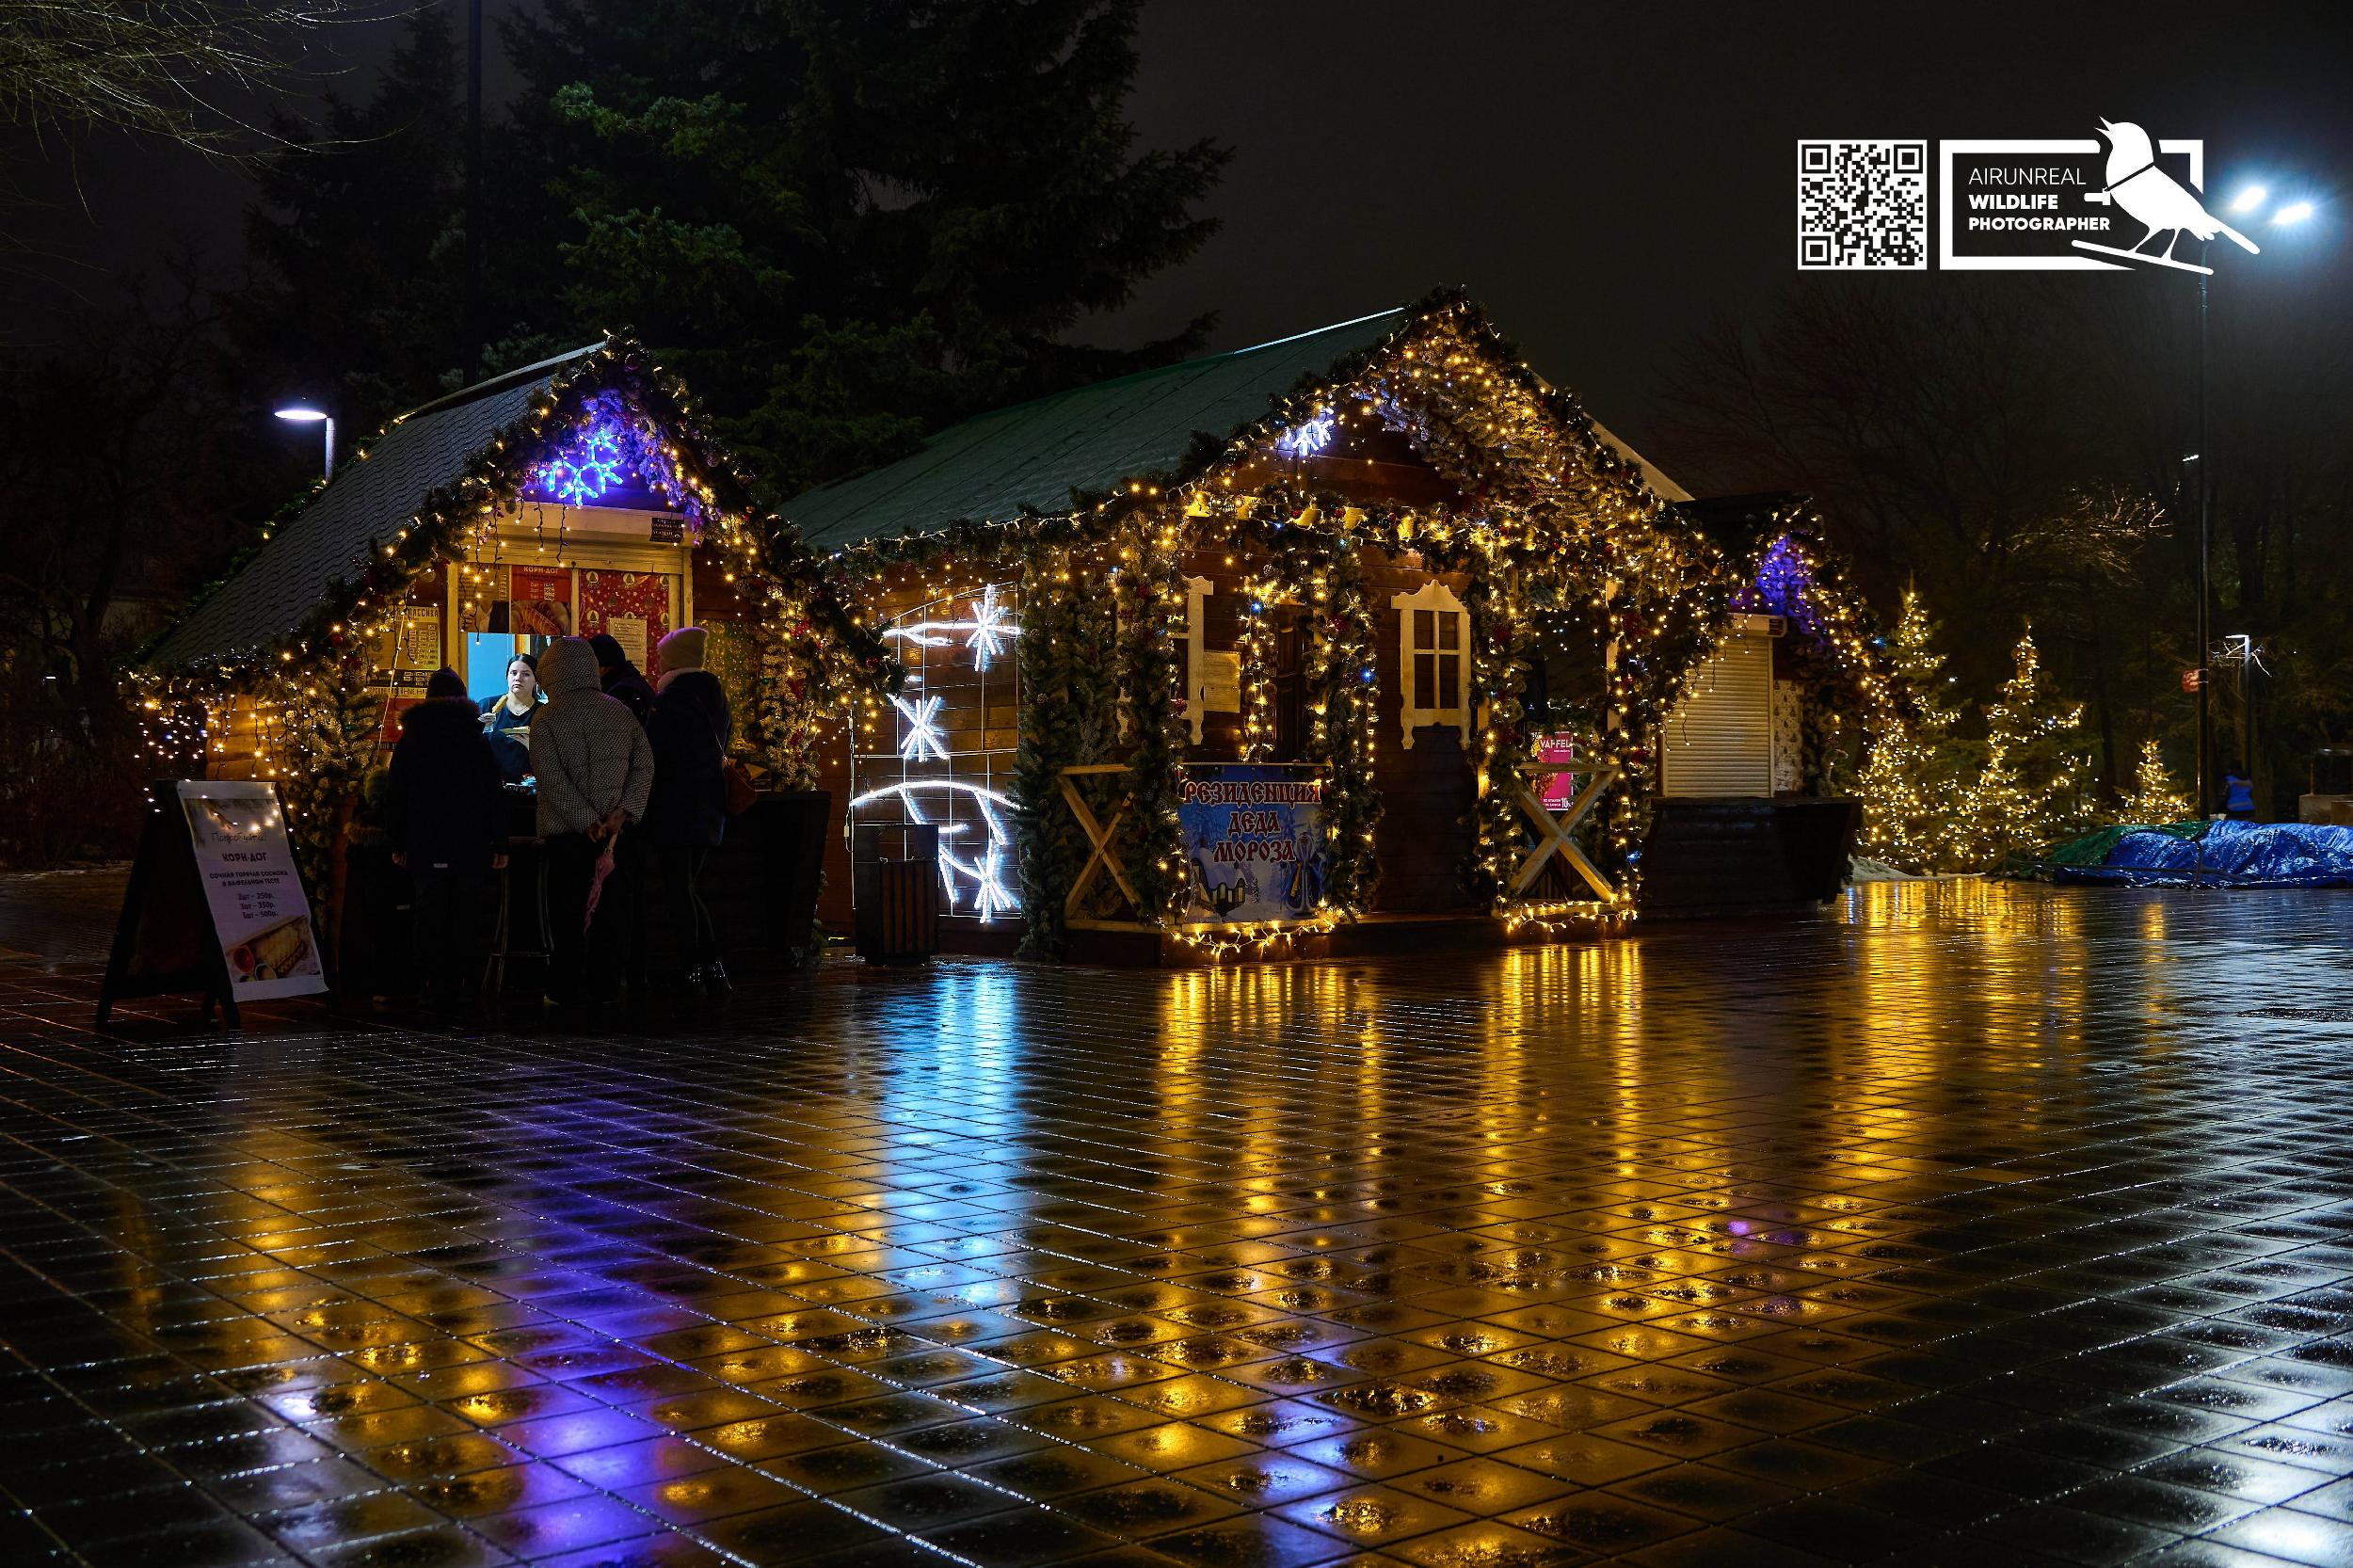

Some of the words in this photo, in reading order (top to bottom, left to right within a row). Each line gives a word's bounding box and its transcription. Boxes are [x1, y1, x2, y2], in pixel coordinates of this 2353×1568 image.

[1183, 781, 1322, 809] РЕЗИДЕНЦИЯ
[1227, 810, 1281, 838] ДЕДА
[222, 852, 266, 862] КОРН-ДОГ
[1213, 840, 1297, 863] МОРОЗА
